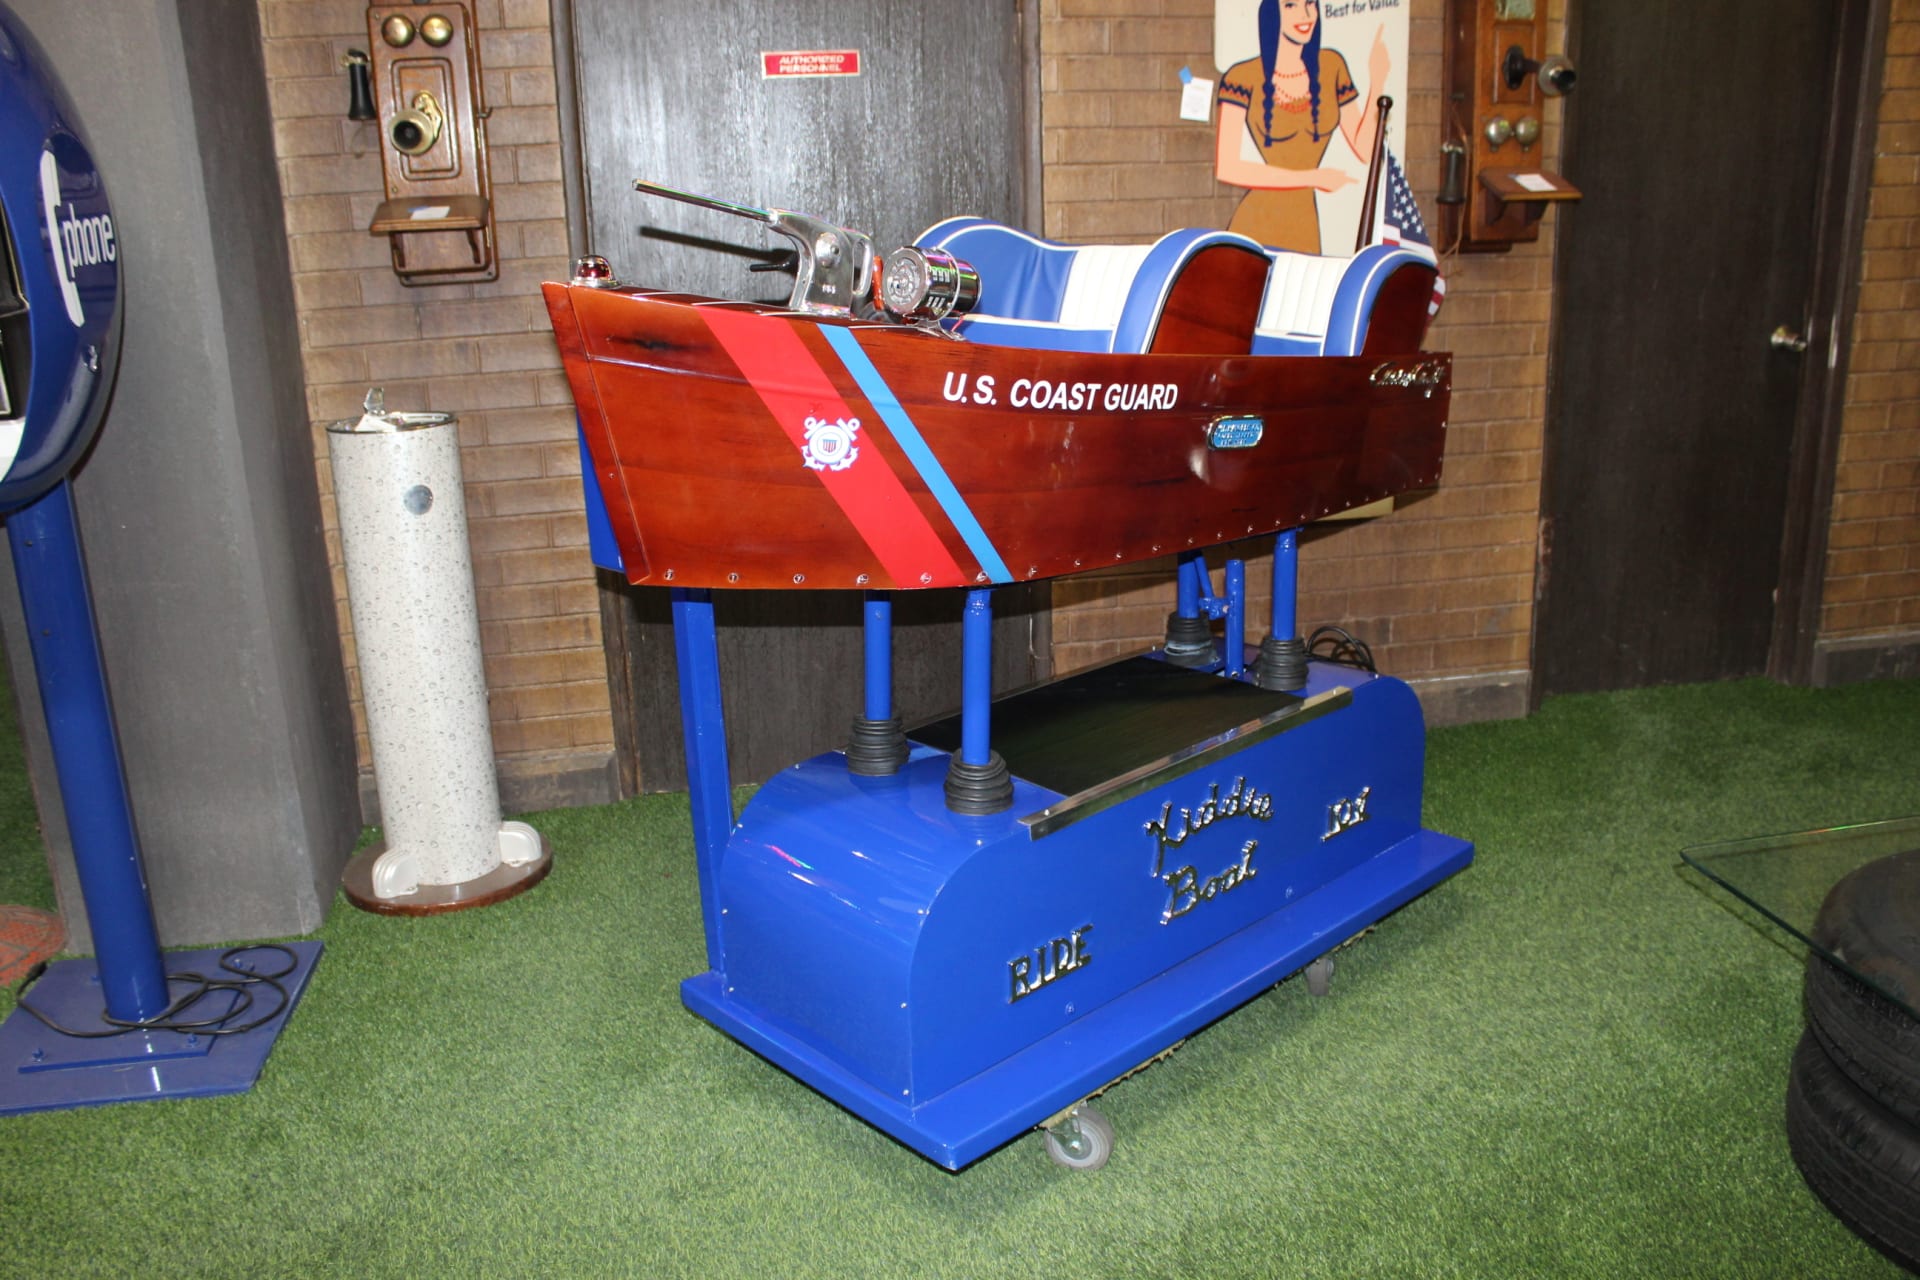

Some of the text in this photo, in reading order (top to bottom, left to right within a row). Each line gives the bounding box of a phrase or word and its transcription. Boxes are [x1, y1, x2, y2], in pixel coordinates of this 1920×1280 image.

[1325, 3, 1349, 18] Best
[1352, 0, 1366, 14] for
[779, 55, 845, 65] AUTHORIZED
[779, 64, 842, 73] PERSONNEL
[62, 203, 116, 278] phone
[1010, 379, 1102, 411] COAST
[1103, 384, 1178, 411] GUARD
[1143, 776, 1274, 878] Kiddie
[1159, 839, 1259, 926] Boat
[1007, 924, 1094, 1004] RIDE
